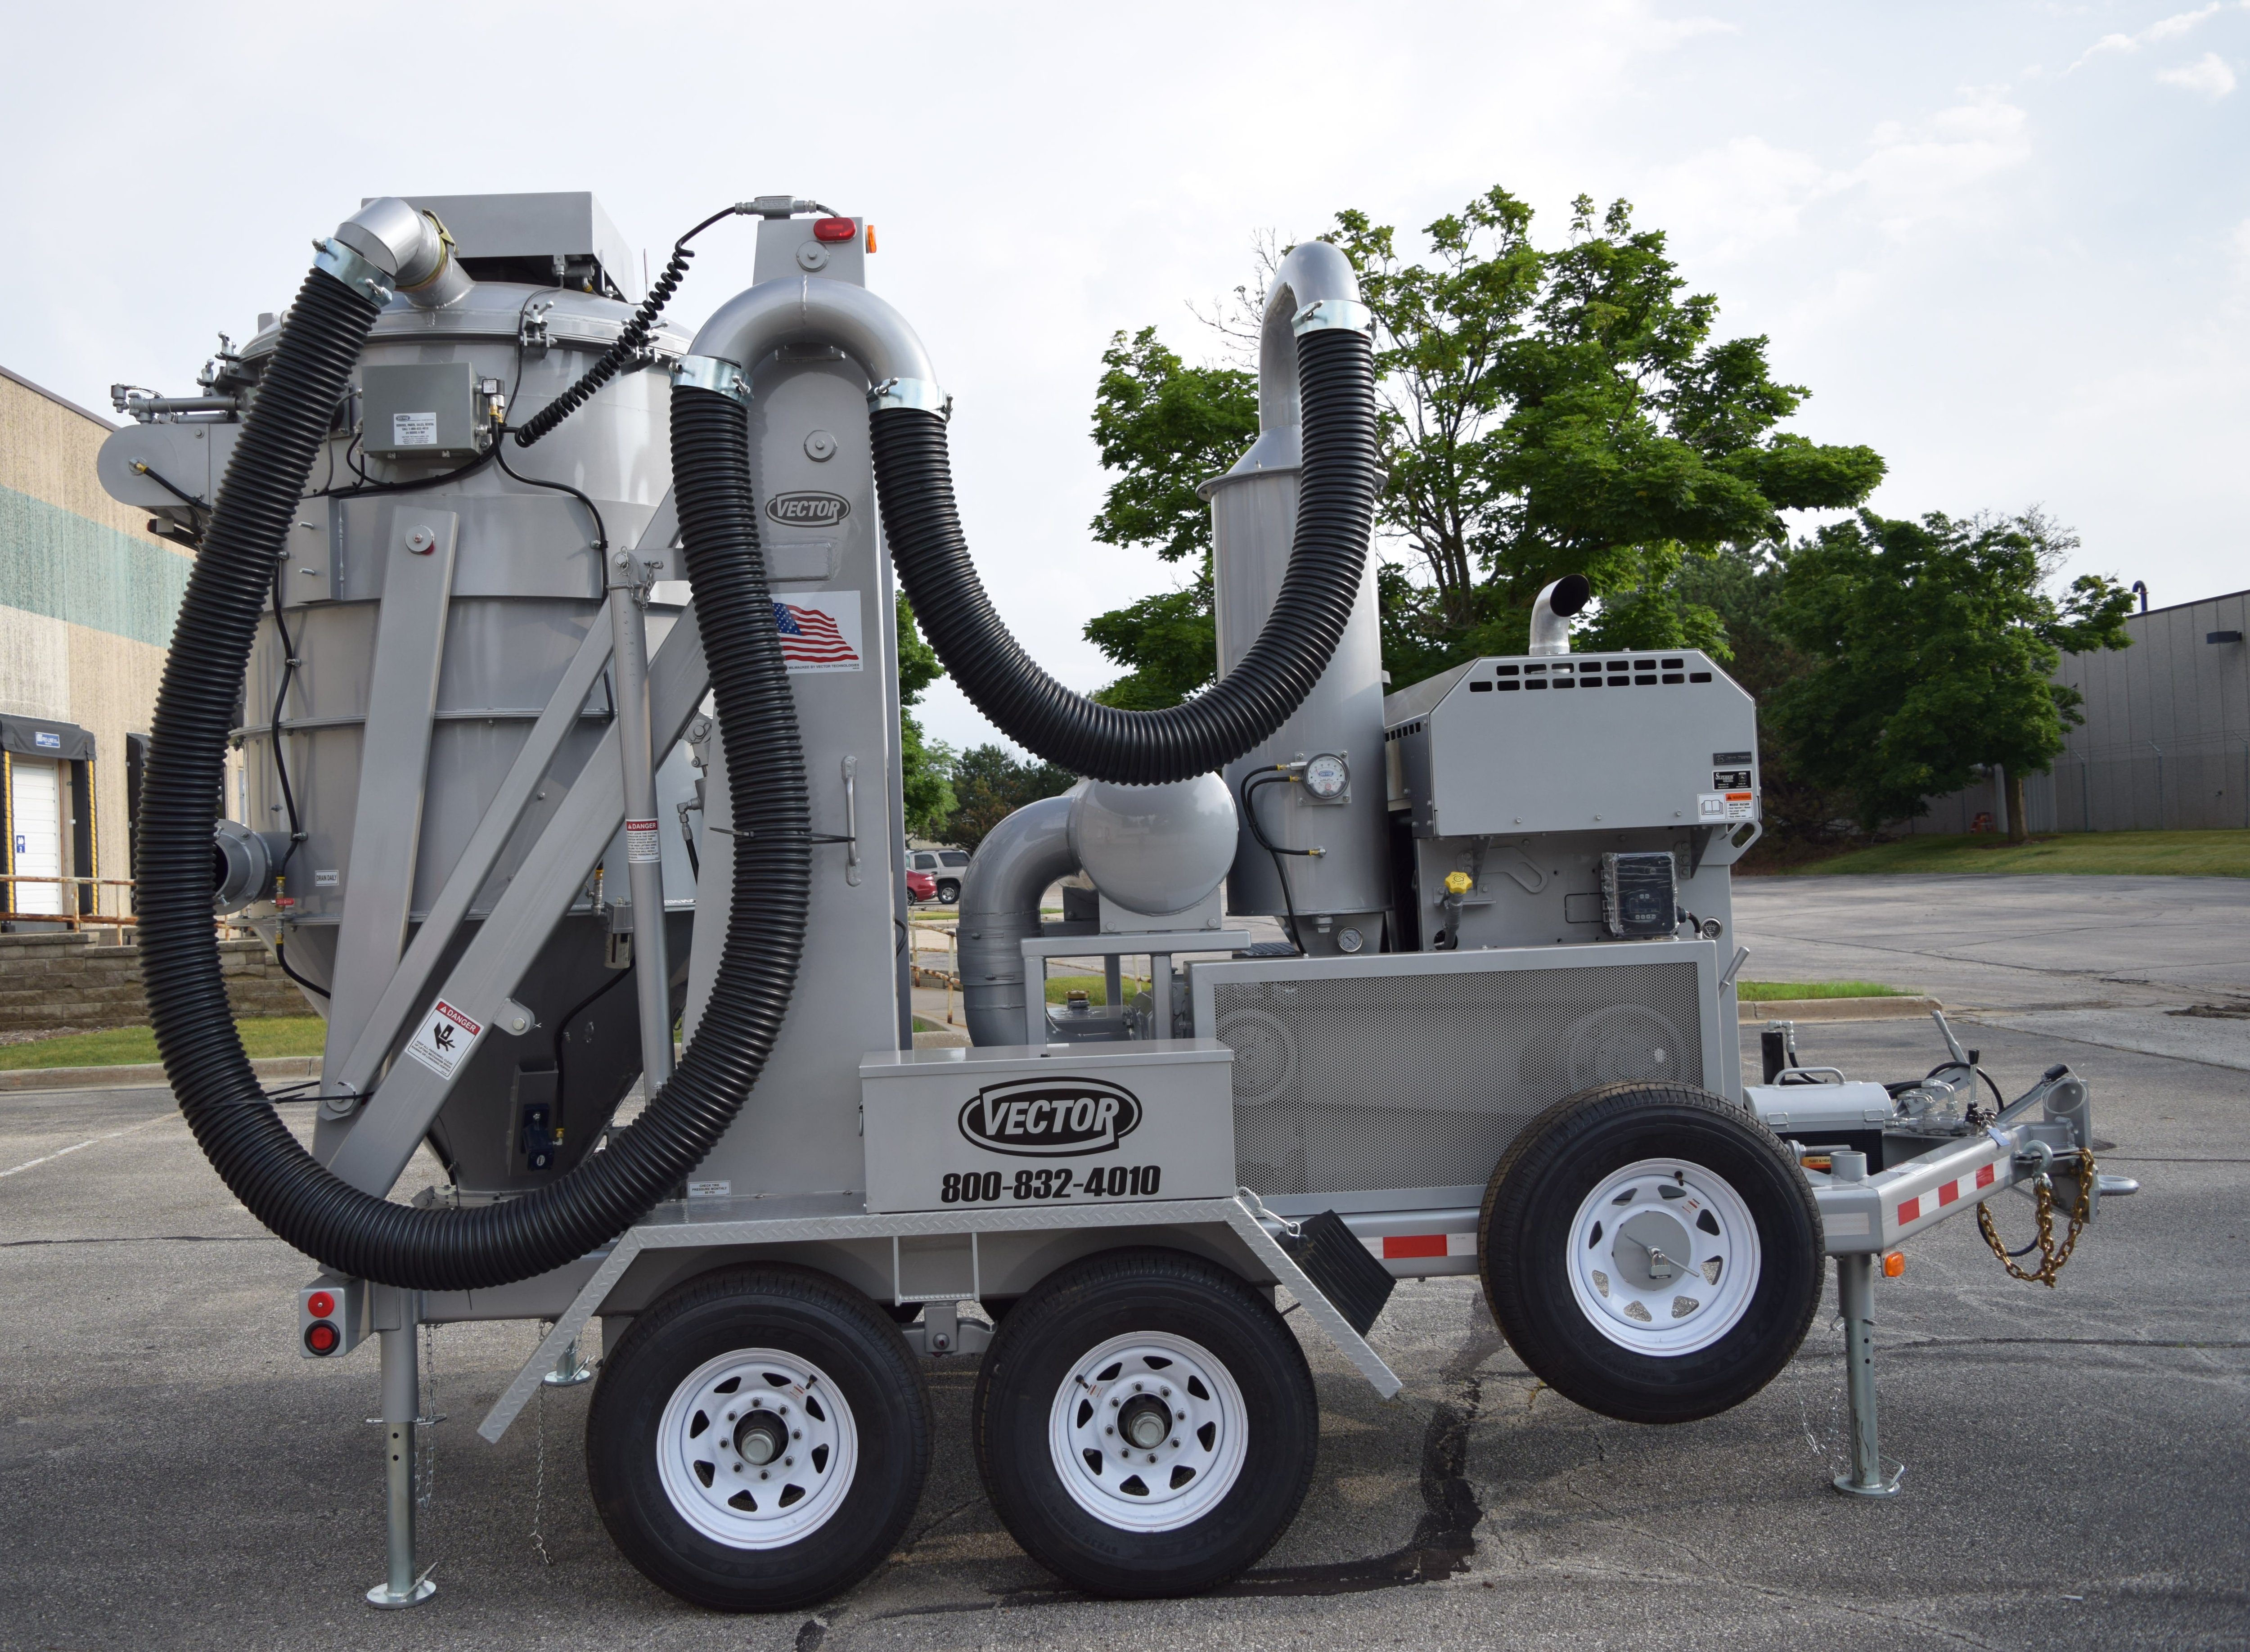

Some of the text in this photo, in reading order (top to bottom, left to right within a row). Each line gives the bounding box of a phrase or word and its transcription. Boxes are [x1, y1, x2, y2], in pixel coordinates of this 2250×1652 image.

[777, 500, 841, 518] VECTOR
[447, 1009, 477, 1032] DANGER
[418, 1045, 428, 1053] LIFTING
[428, 1052, 443, 1064] MECHANISM
[429, 1048, 443, 1059] PERSONNEL
[439, 1064, 450, 1072] HOPPER
[984, 1098, 1120, 1136] VECTOR
[941, 1165, 1161, 1203] 800-832-4010
